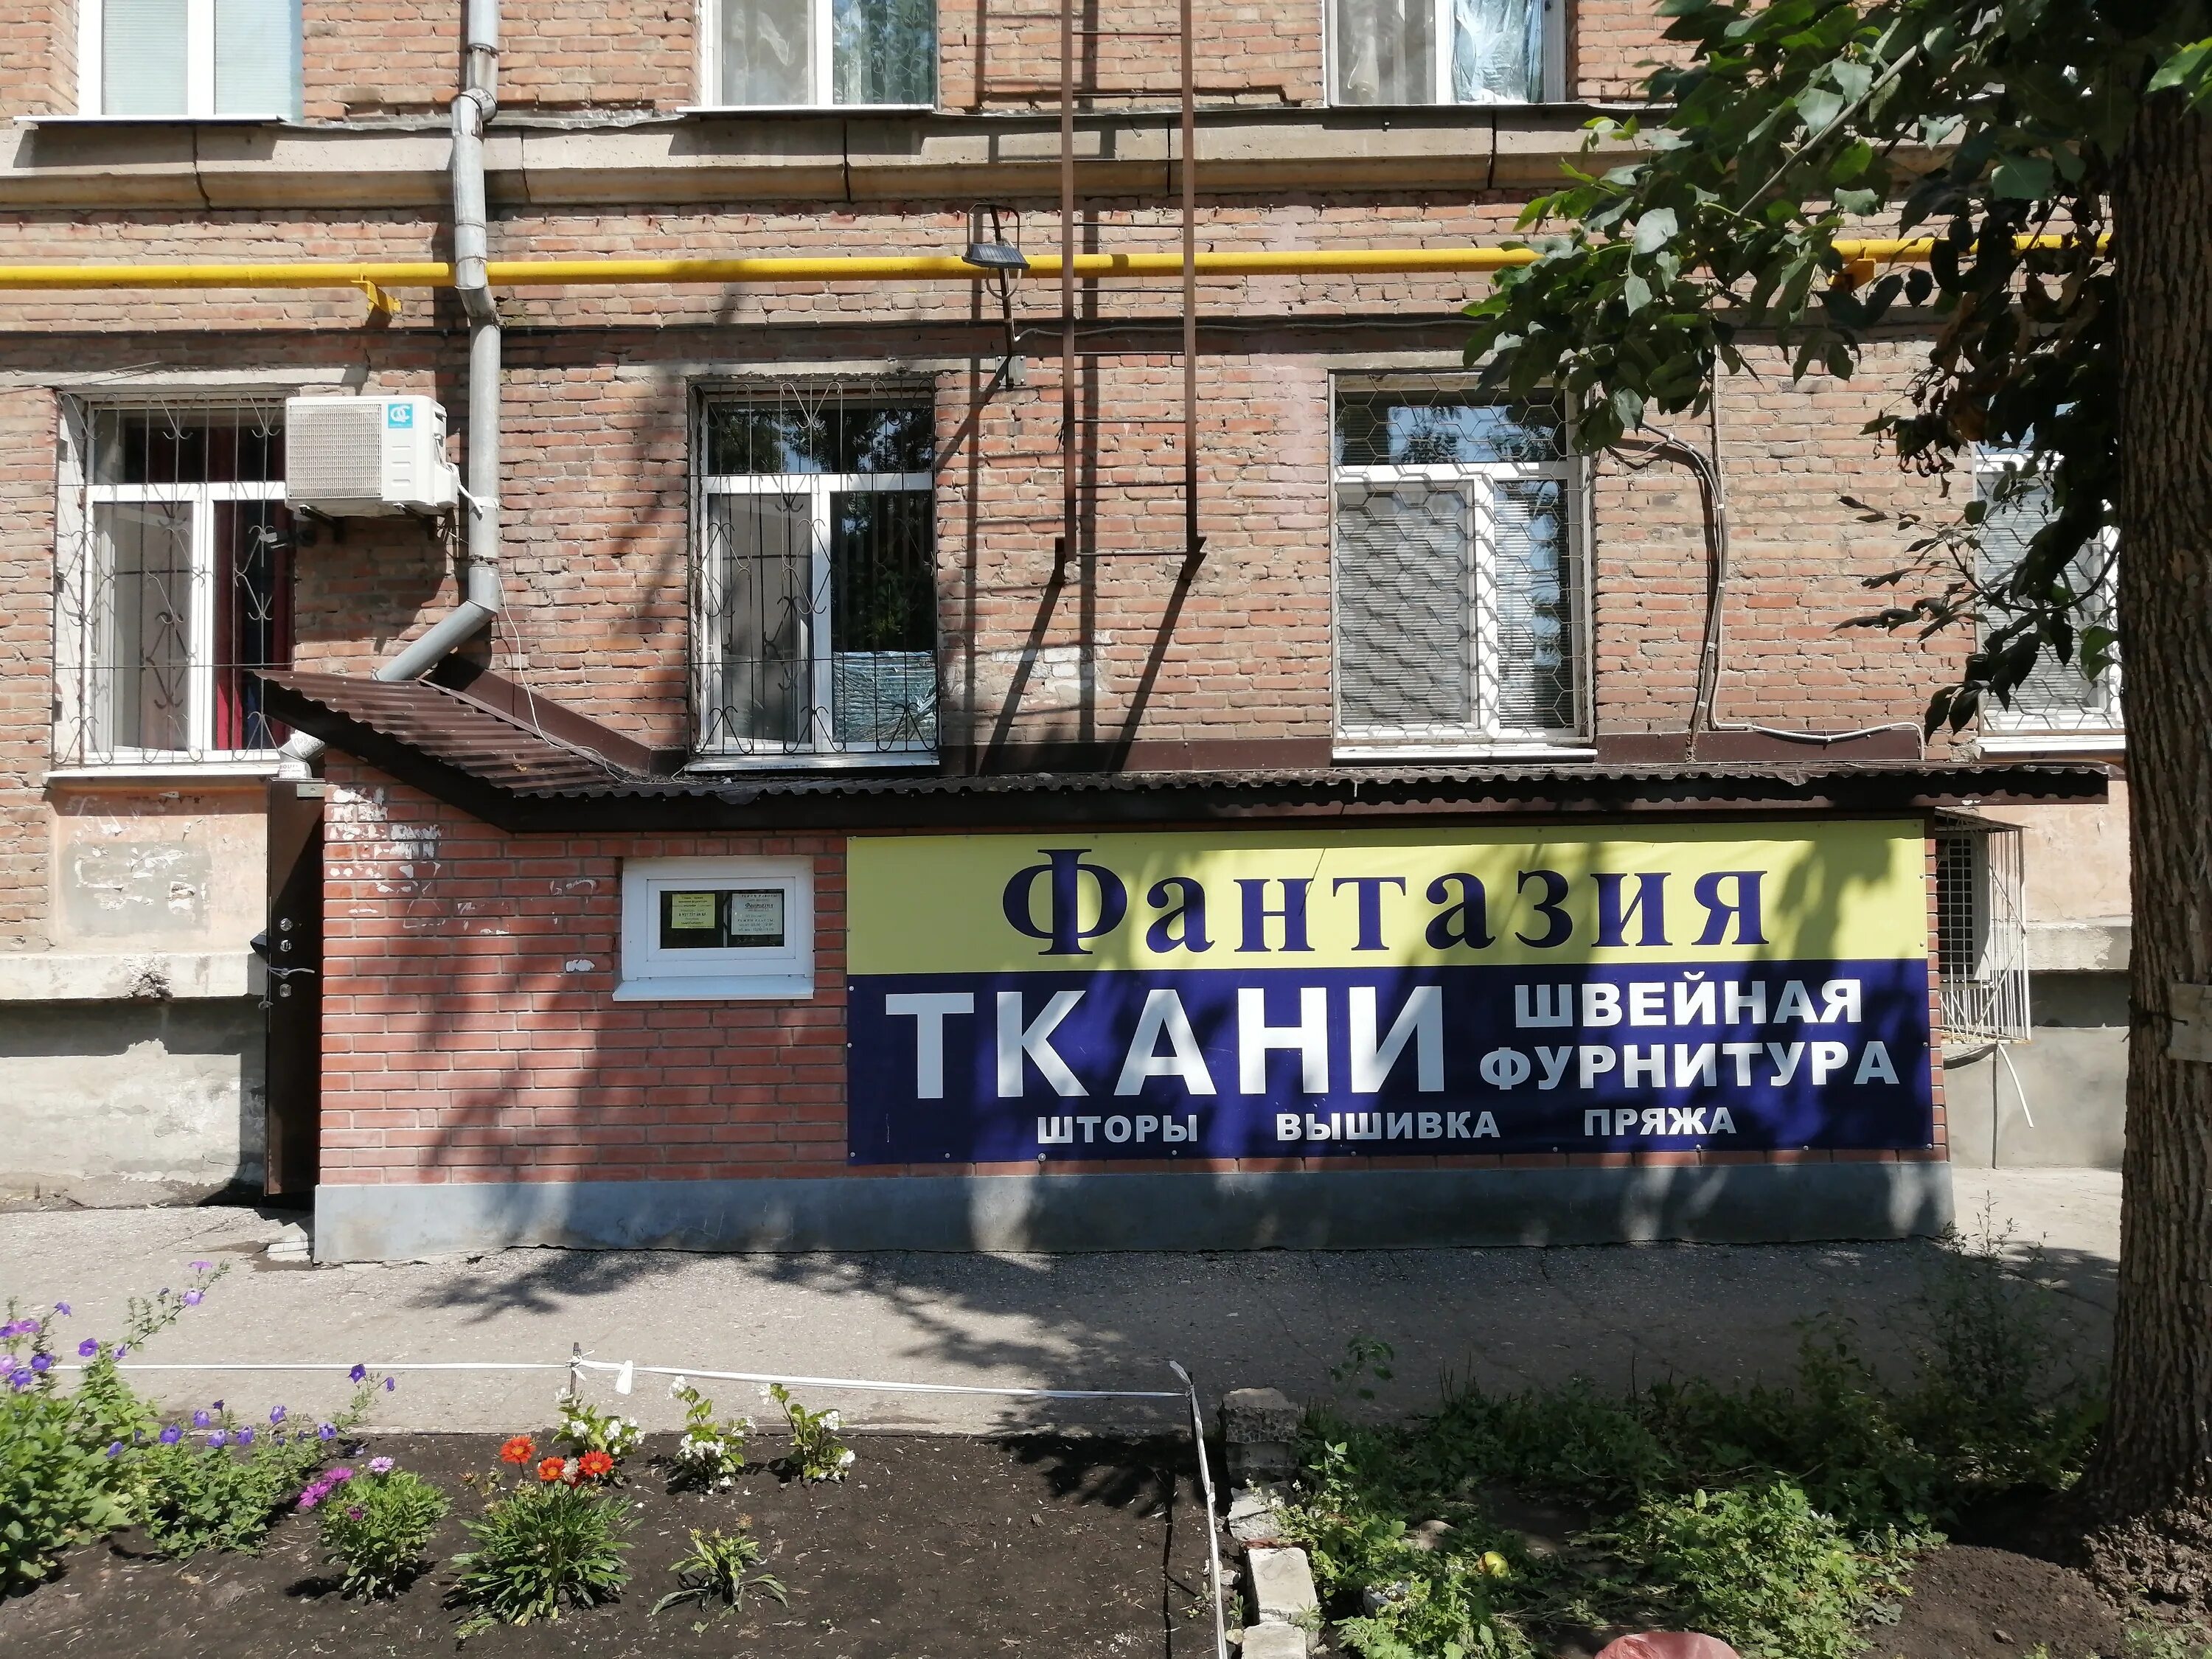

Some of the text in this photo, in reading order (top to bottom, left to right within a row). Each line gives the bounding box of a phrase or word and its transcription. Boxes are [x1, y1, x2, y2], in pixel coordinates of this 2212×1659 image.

[1002, 849, 1770, 956] Фантазия
[1514, 971, 1862, 1029] ШВЕЙНАЯ
[886, 986, 1445, 1099] ТКАНИ
[1480, 1041, 1900, 1091] ФУРНИТУРА
[1037, 1107, 1736, 1144] ШТОРЫ ВЫШИВКА ПРЯЖКА
